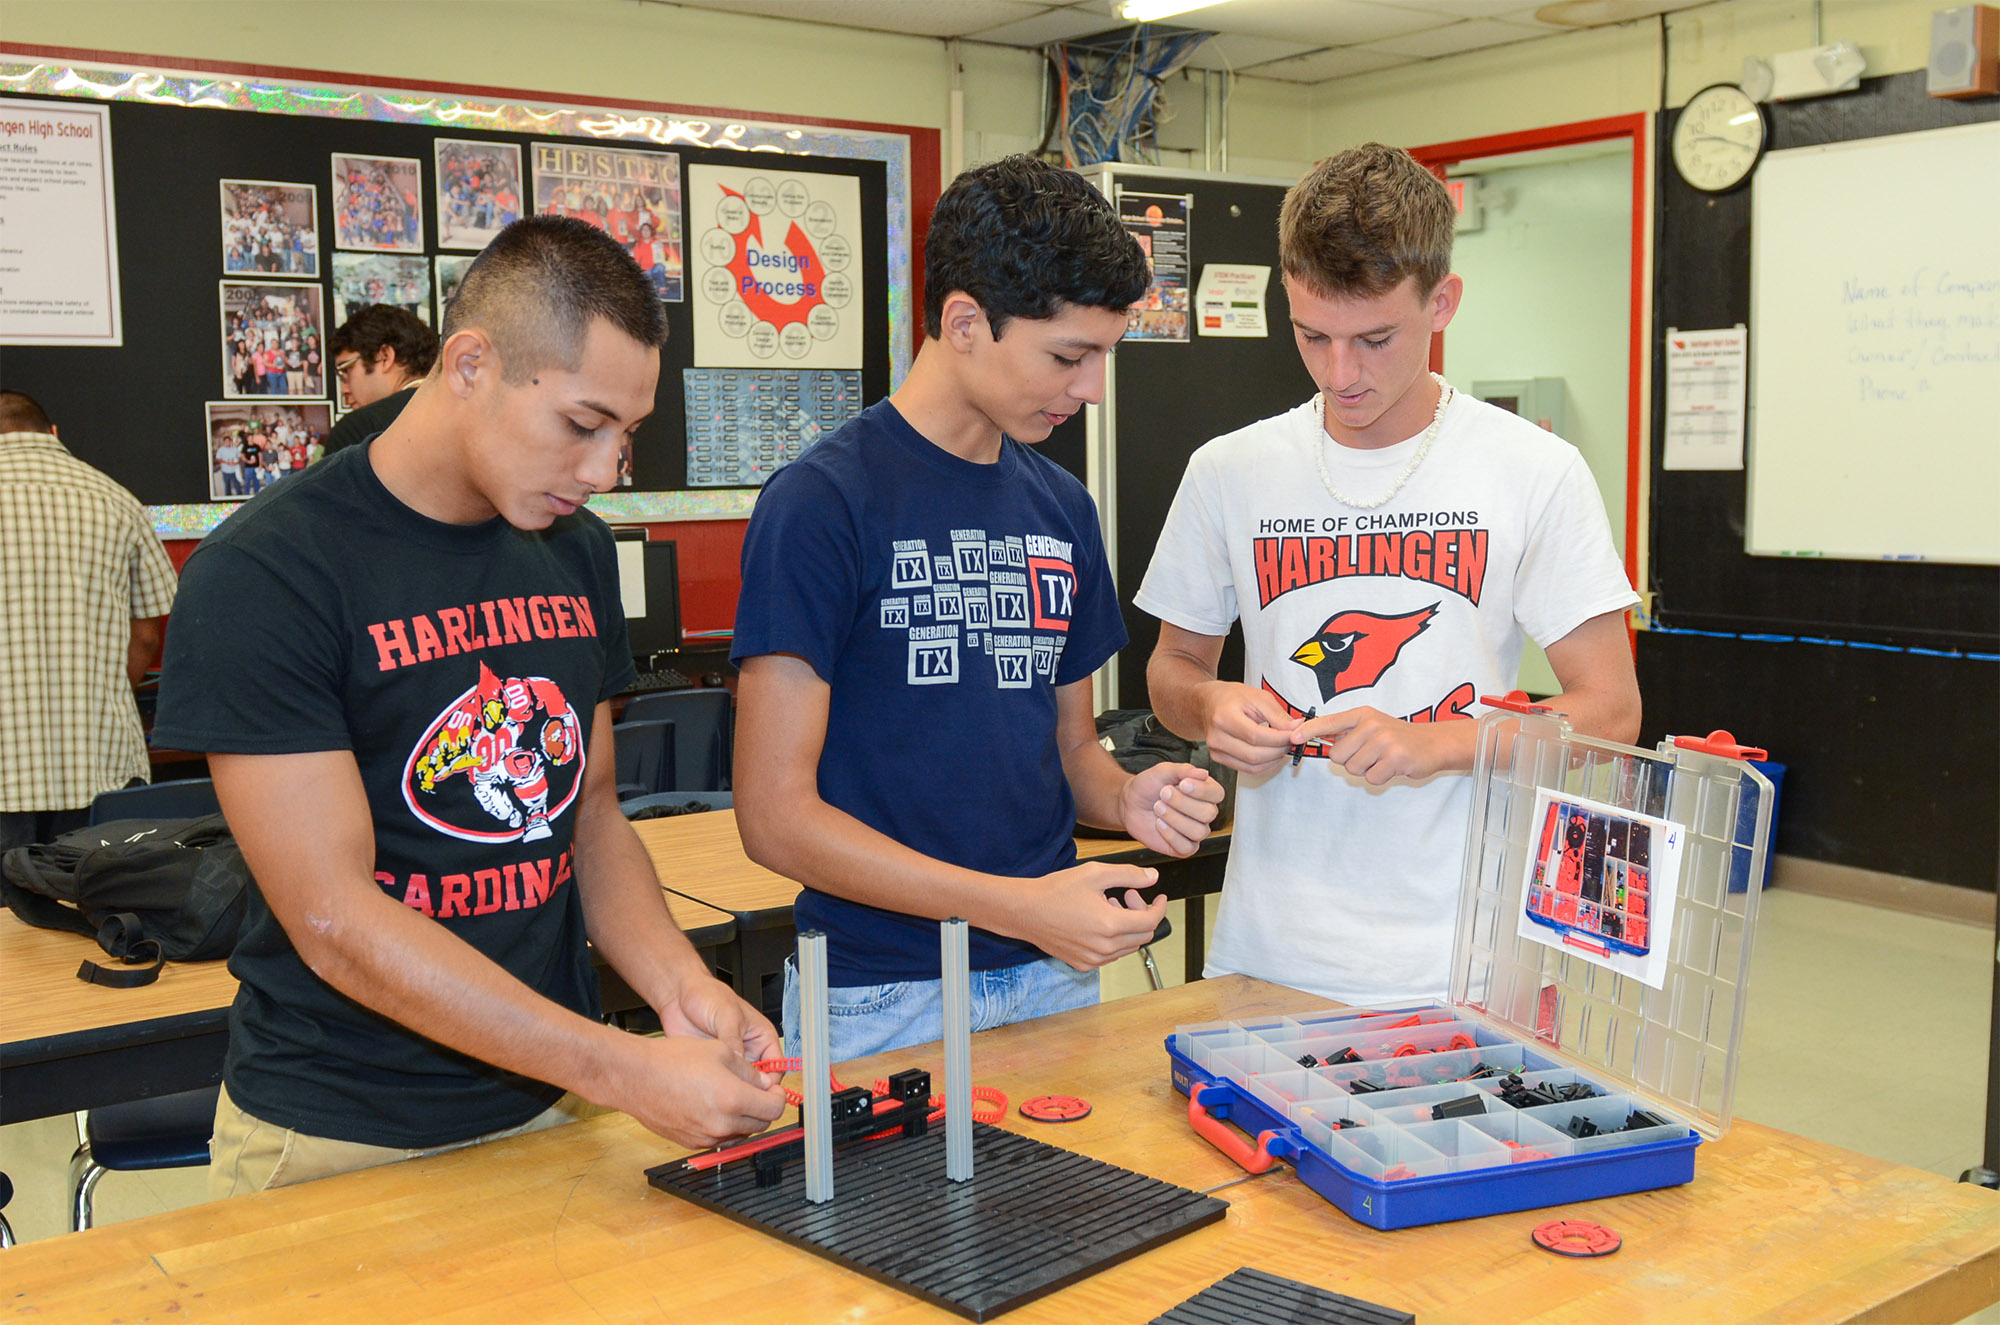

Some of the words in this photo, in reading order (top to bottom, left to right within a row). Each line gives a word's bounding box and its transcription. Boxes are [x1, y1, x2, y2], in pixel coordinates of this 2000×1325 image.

[29, 120, 54, 139] High
[57, 121, 93, 138] School
[539, 148, 678, 185] HESTEC
[747, 249, 810, 273] Design
[742, 276, 817, 296] Process
[1259, 518, 1315, 534] HOME
[1322, 517, 1349, 532] OF
[1355, 510, 1480, 531] CHAMPIONS
[950, 528, 986, 541] GENERATION
[961, 550, 983, 572] TX
[993, 550, 1004, 561] TX
[1010, 548, 1022, 562] TX
[898, 558, 924, 580] TX
[939, 565, 950, 576] TX
[990, 571, 1027, 586] GENERATION
[1253, 529, 1489, 611] HARLINGEN
[1041, 574, 1072, 617] TX
[940, 598, 958, 614] TX
[970, 604, 987, 622] TX
[997, 594, 1024, 618] TX
[886, 610, 903, 623] TX
[368, 595, 598, 672] HARLINGEN
[909, 624, 959, 640] GENERATION
[993, 635, 1032, 647] GENERATION
[919, 649, 949, 675] TX
[1001, 656, 1024, 679] TX
[1034, 651, 1048, 668] TX
[1668, 831, 1677, 850] 4
[1362, 1195, 1373, 1217] 4
